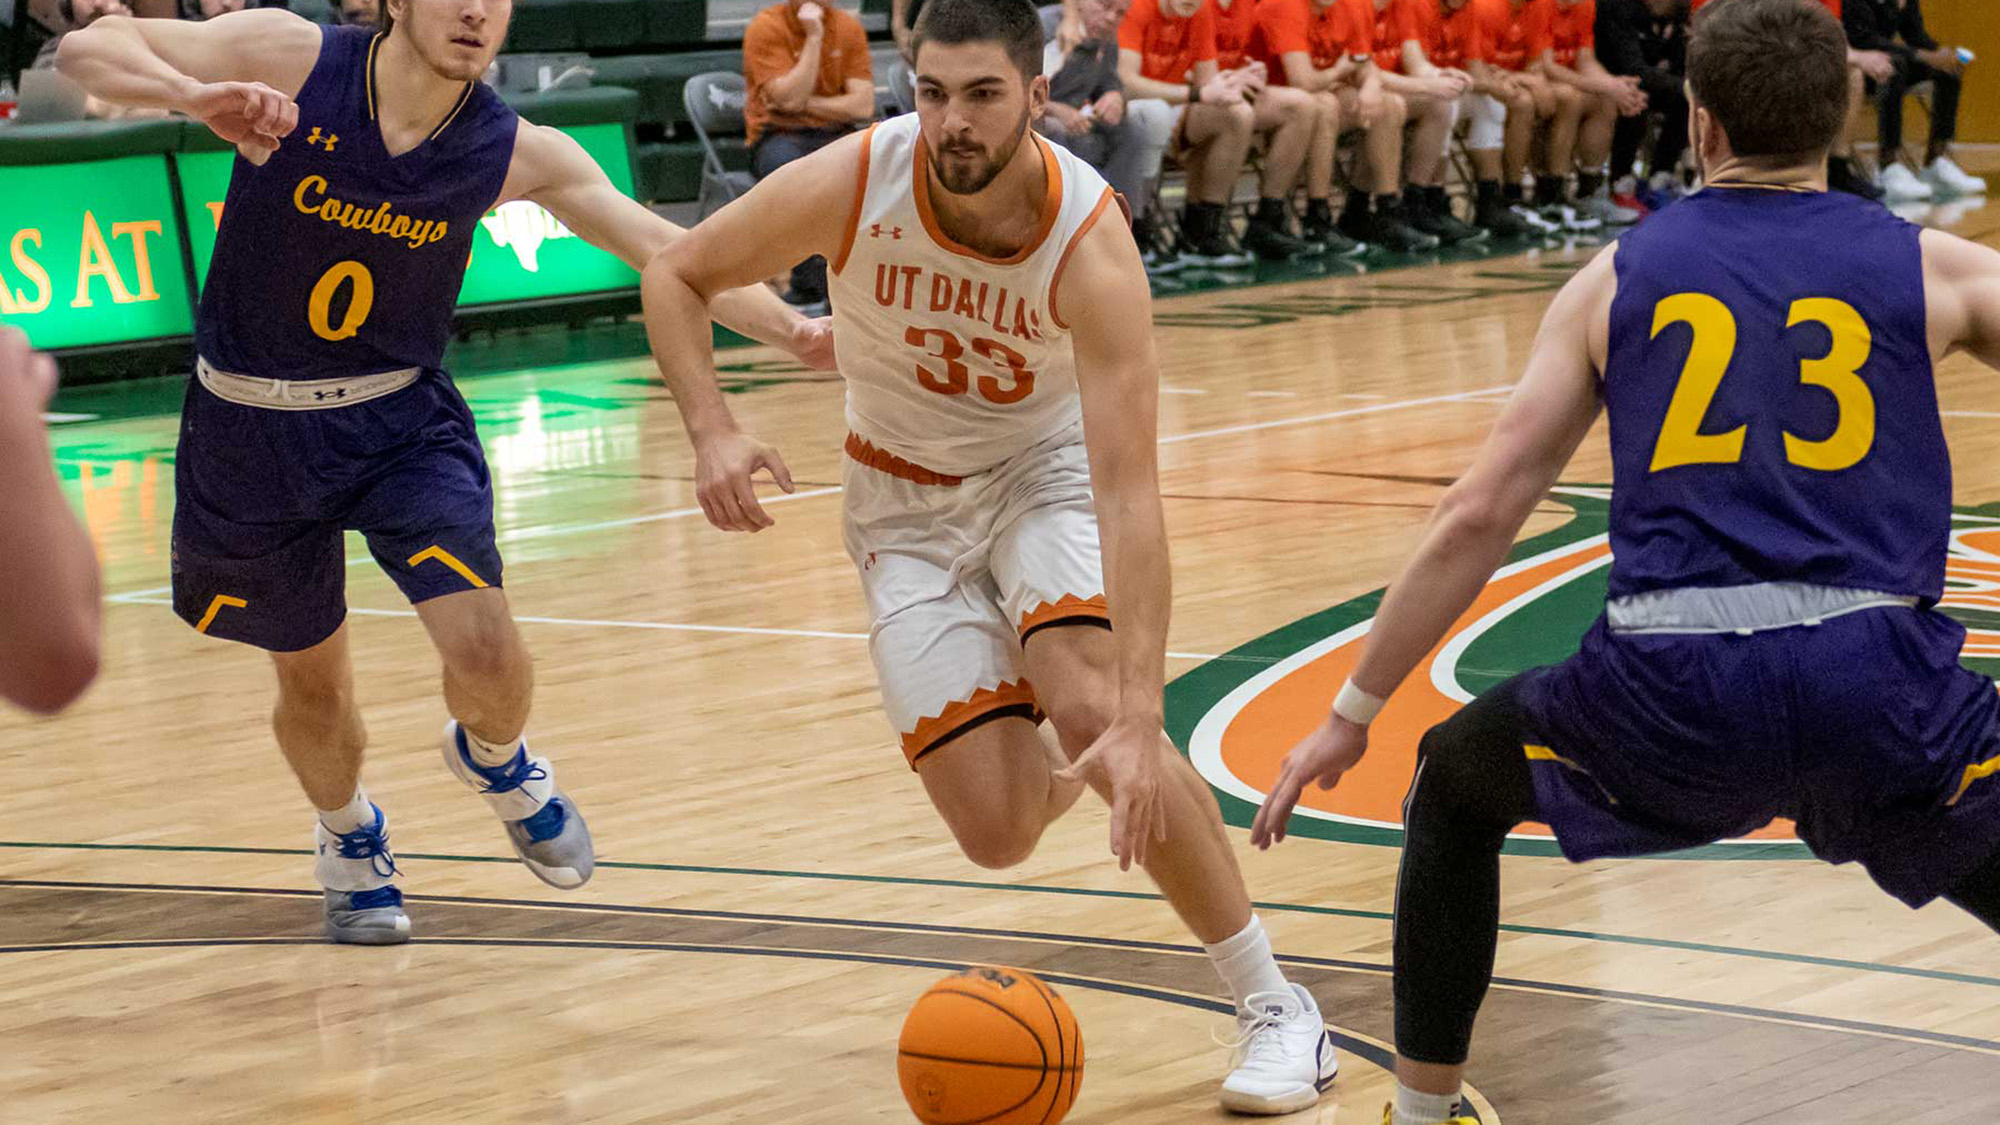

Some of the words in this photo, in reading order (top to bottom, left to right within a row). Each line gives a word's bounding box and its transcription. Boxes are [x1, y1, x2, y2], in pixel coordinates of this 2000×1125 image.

[293, 174, 448, 249] Cowboys
[70, 210, 162, 308] AT
[875, 263, 923, 310] UT
[308, 260, 374, 341] 0
[905, 325, 1035, 404] 33
[1649, 292, 1876, 473] 23
